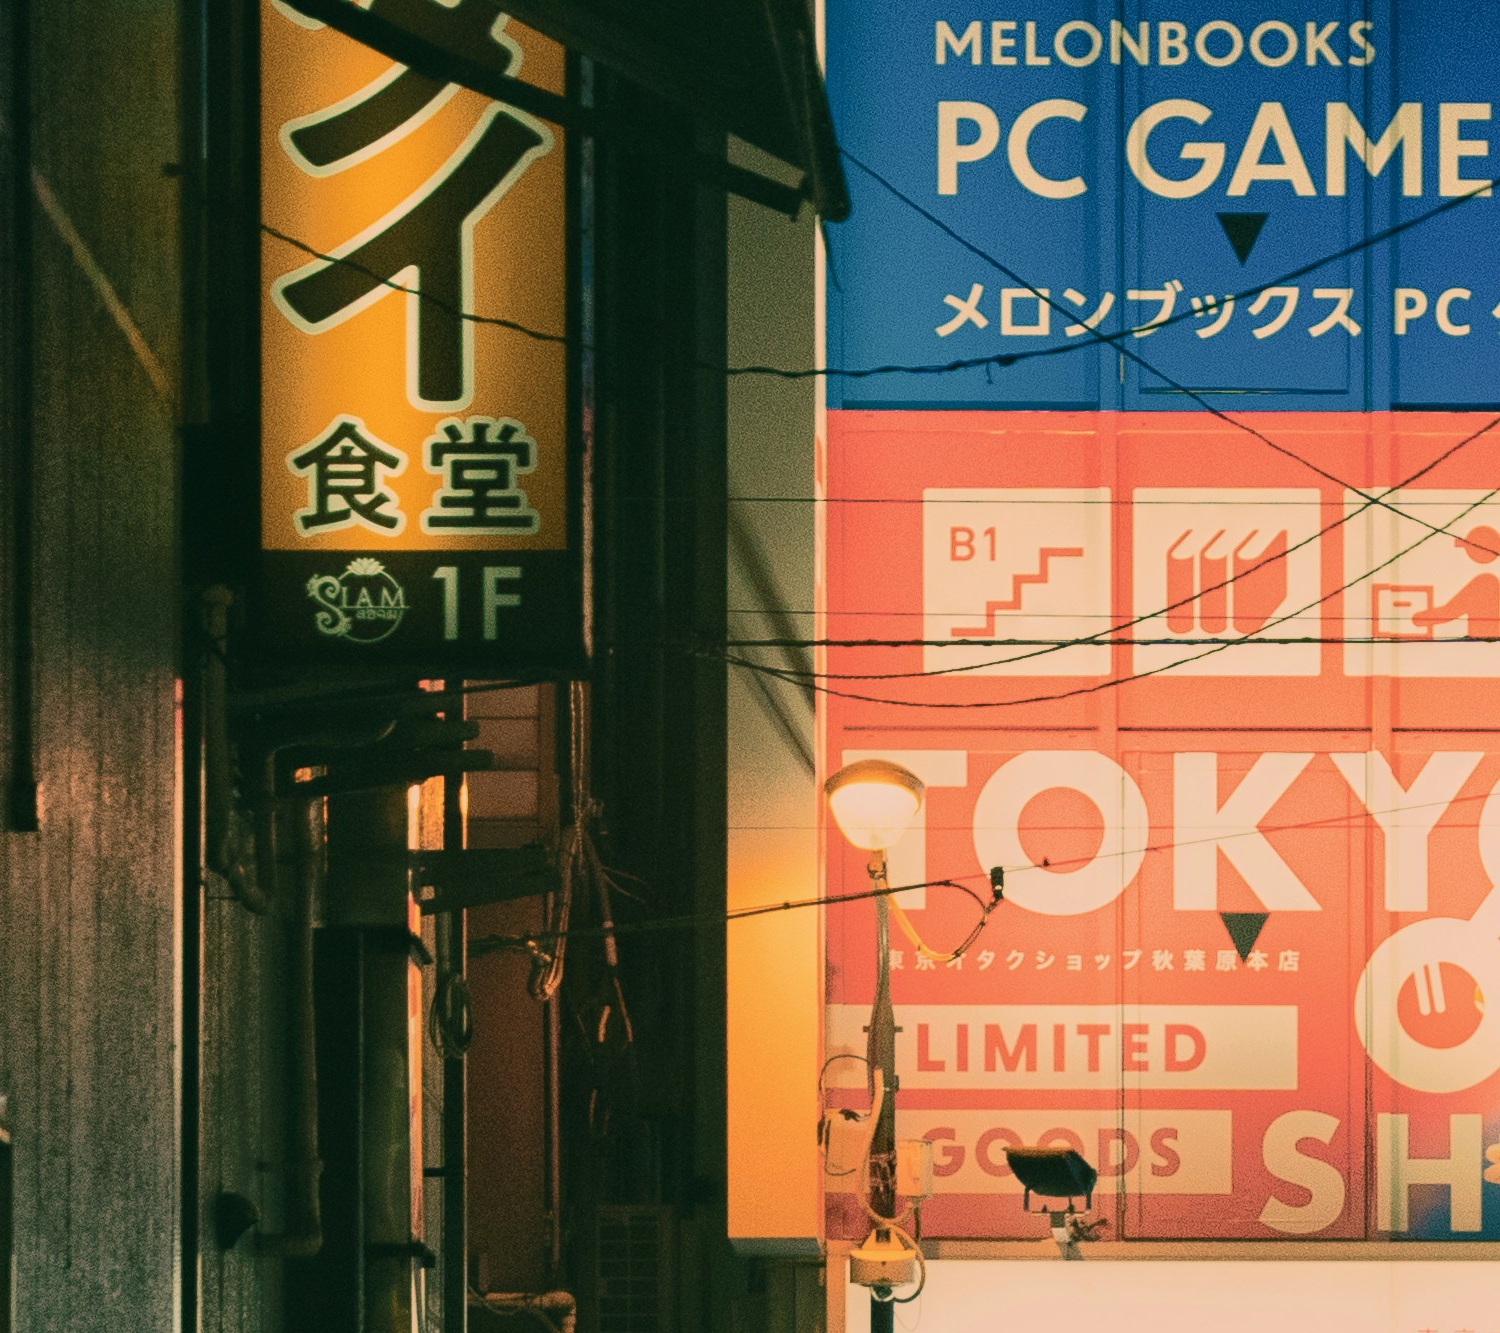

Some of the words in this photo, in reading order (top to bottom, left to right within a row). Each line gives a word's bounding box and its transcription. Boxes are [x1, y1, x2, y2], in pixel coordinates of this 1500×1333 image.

[934, 20, 1376, 67] MELONBOOKS
[936, 99, 1089, 200] PC
[1124, 99, 1493, 200] GAME
[934, 281, 1358, 341] メロンブックス
[1394, 287, 1472, 337] PC
[286, 413, 540, 538] 食堂
[950, 527, 997, 562] B1
[432, 566, 522, 641] 1F
[915, 1023, 1208, 1073] LIMITED
